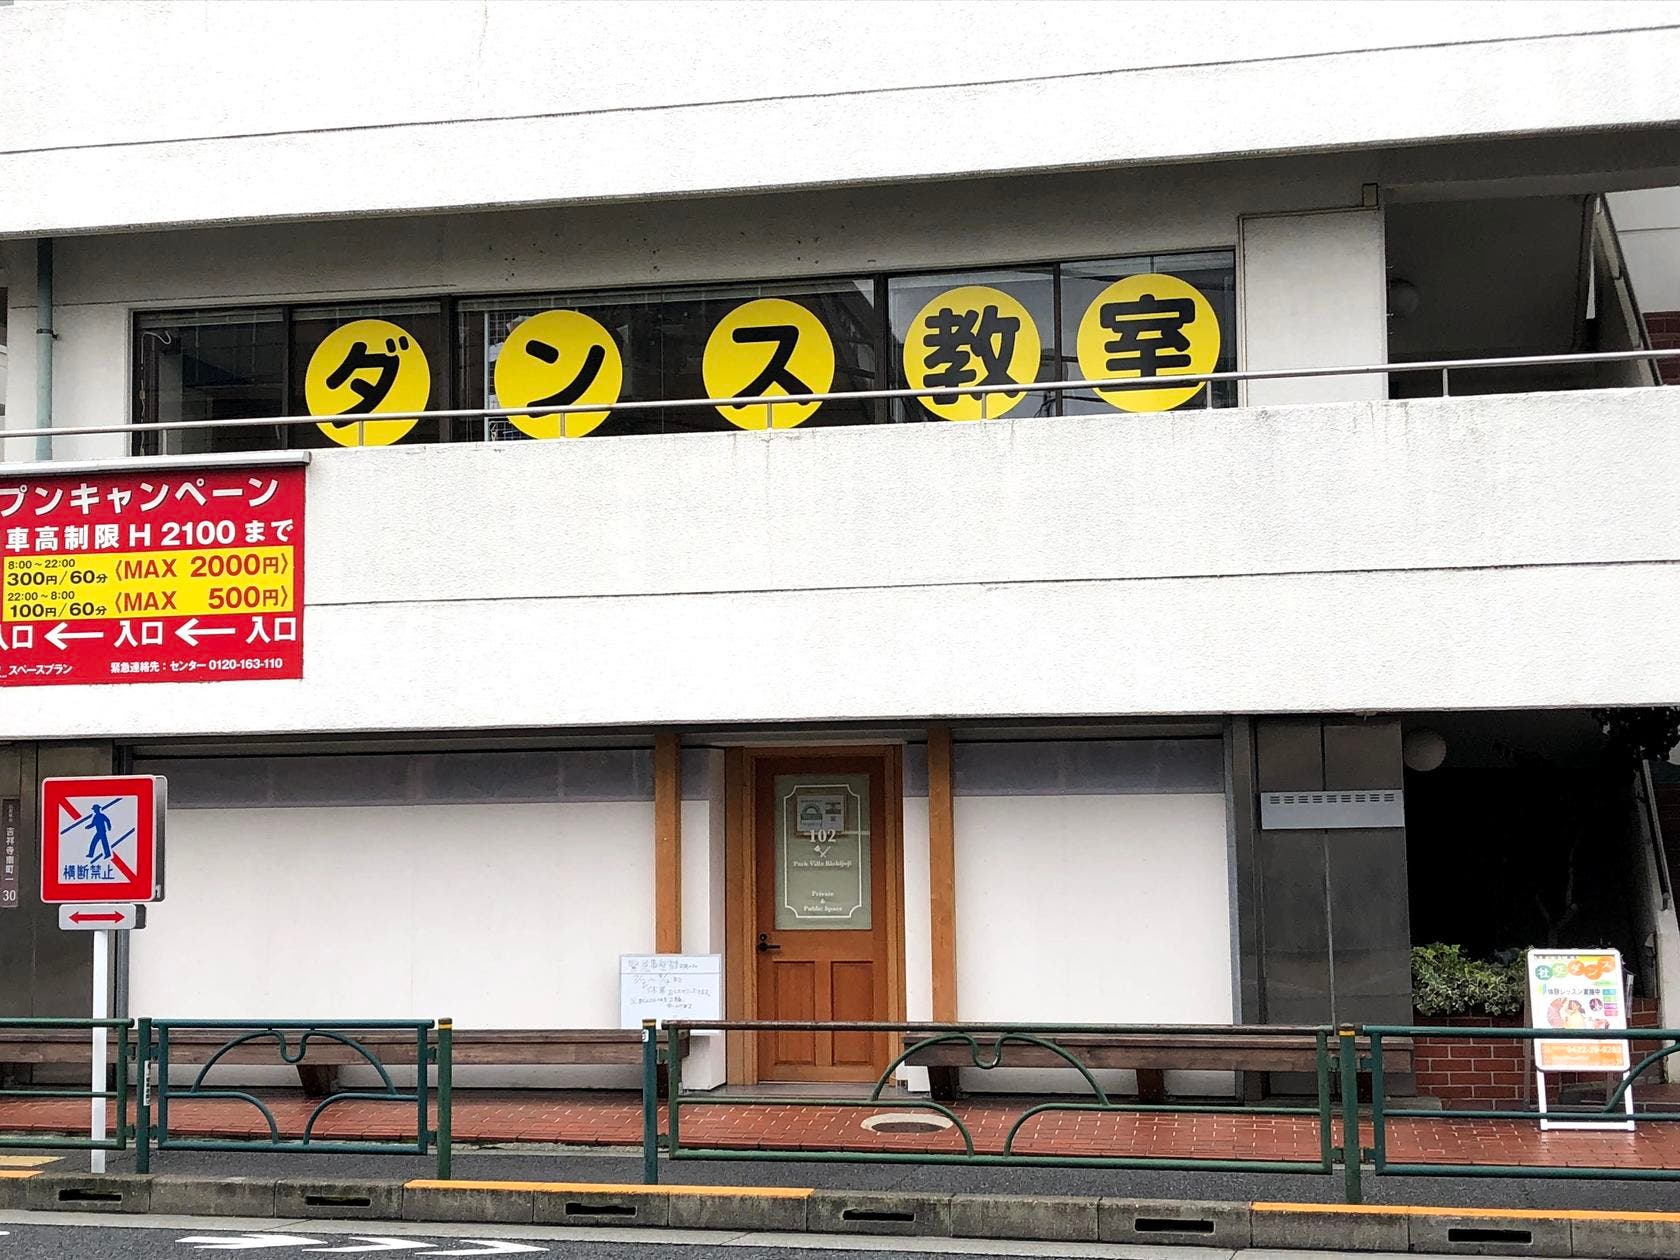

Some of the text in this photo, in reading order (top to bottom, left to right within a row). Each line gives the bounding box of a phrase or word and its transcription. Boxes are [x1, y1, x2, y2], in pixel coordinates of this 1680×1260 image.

[326, 294, 1206, 428] ダンス教室
[0, 479, 278, 517] プンキャンペーン
[5, 519, 294, 552] 車高制限 H 2100 まで
[114, 620, 164, 648] 入口
[245, 616, 297, 644] 入口
[208, 657, 283, 671] 0120-163-110
[809, 828, 837, 843] 102
[63, 864, 115, 880] 横断禁止
[2, 889, 16, 902] 30
